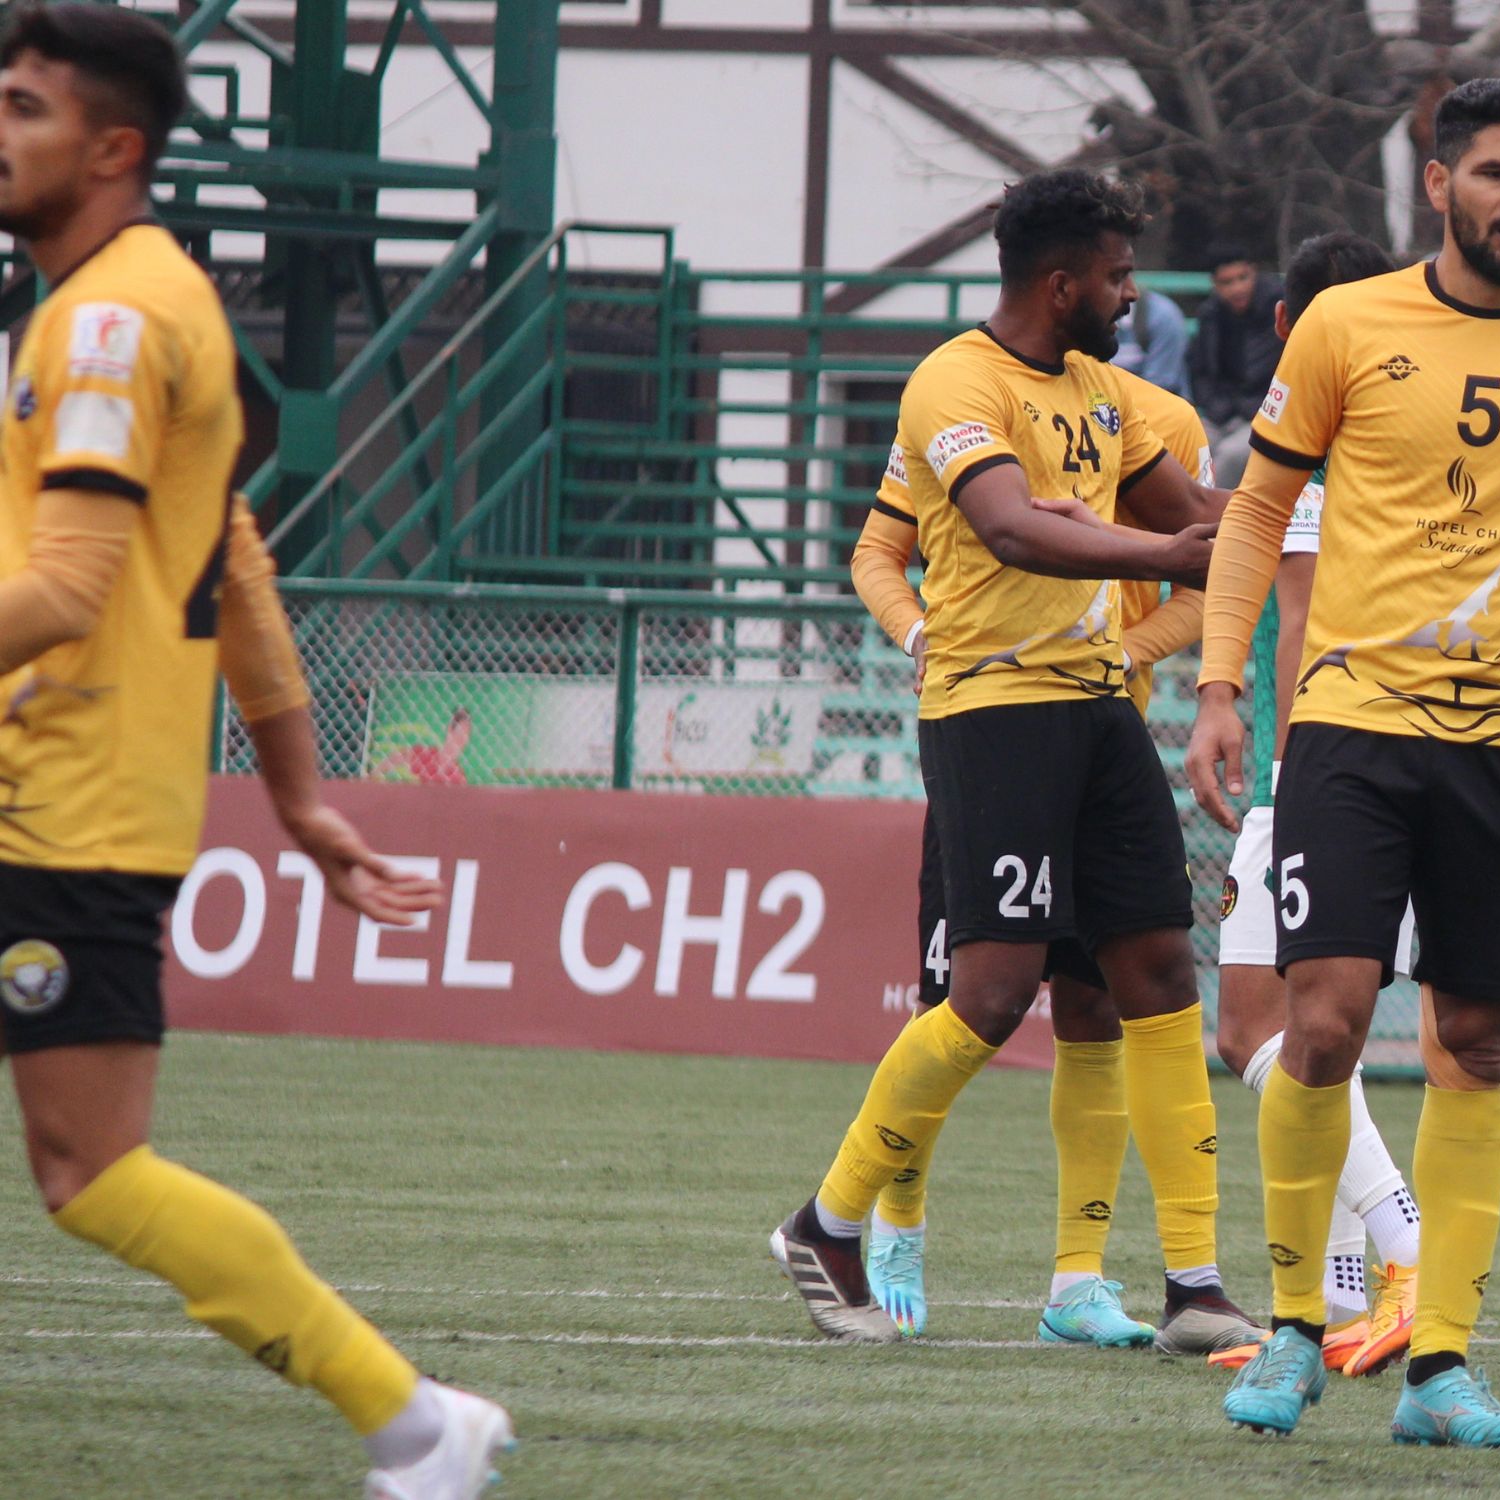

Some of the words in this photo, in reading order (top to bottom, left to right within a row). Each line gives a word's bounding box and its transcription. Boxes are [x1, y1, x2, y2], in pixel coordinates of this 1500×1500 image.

[1377, 364, 1420, 372] NIVIA
[949, 424, 984, 441] Hero
[1052, 413, 1101, 474] 24
[1416, 517, 1468, 537] HOTEL
[1419, 531, 1492, 570] Srinagar
[992, 854, 1053, 919] 24
[1280, 852, 1310, 931] 5
[170, 845, 515, 990] OTEL
[558, 860, 827, 1003] CH2
